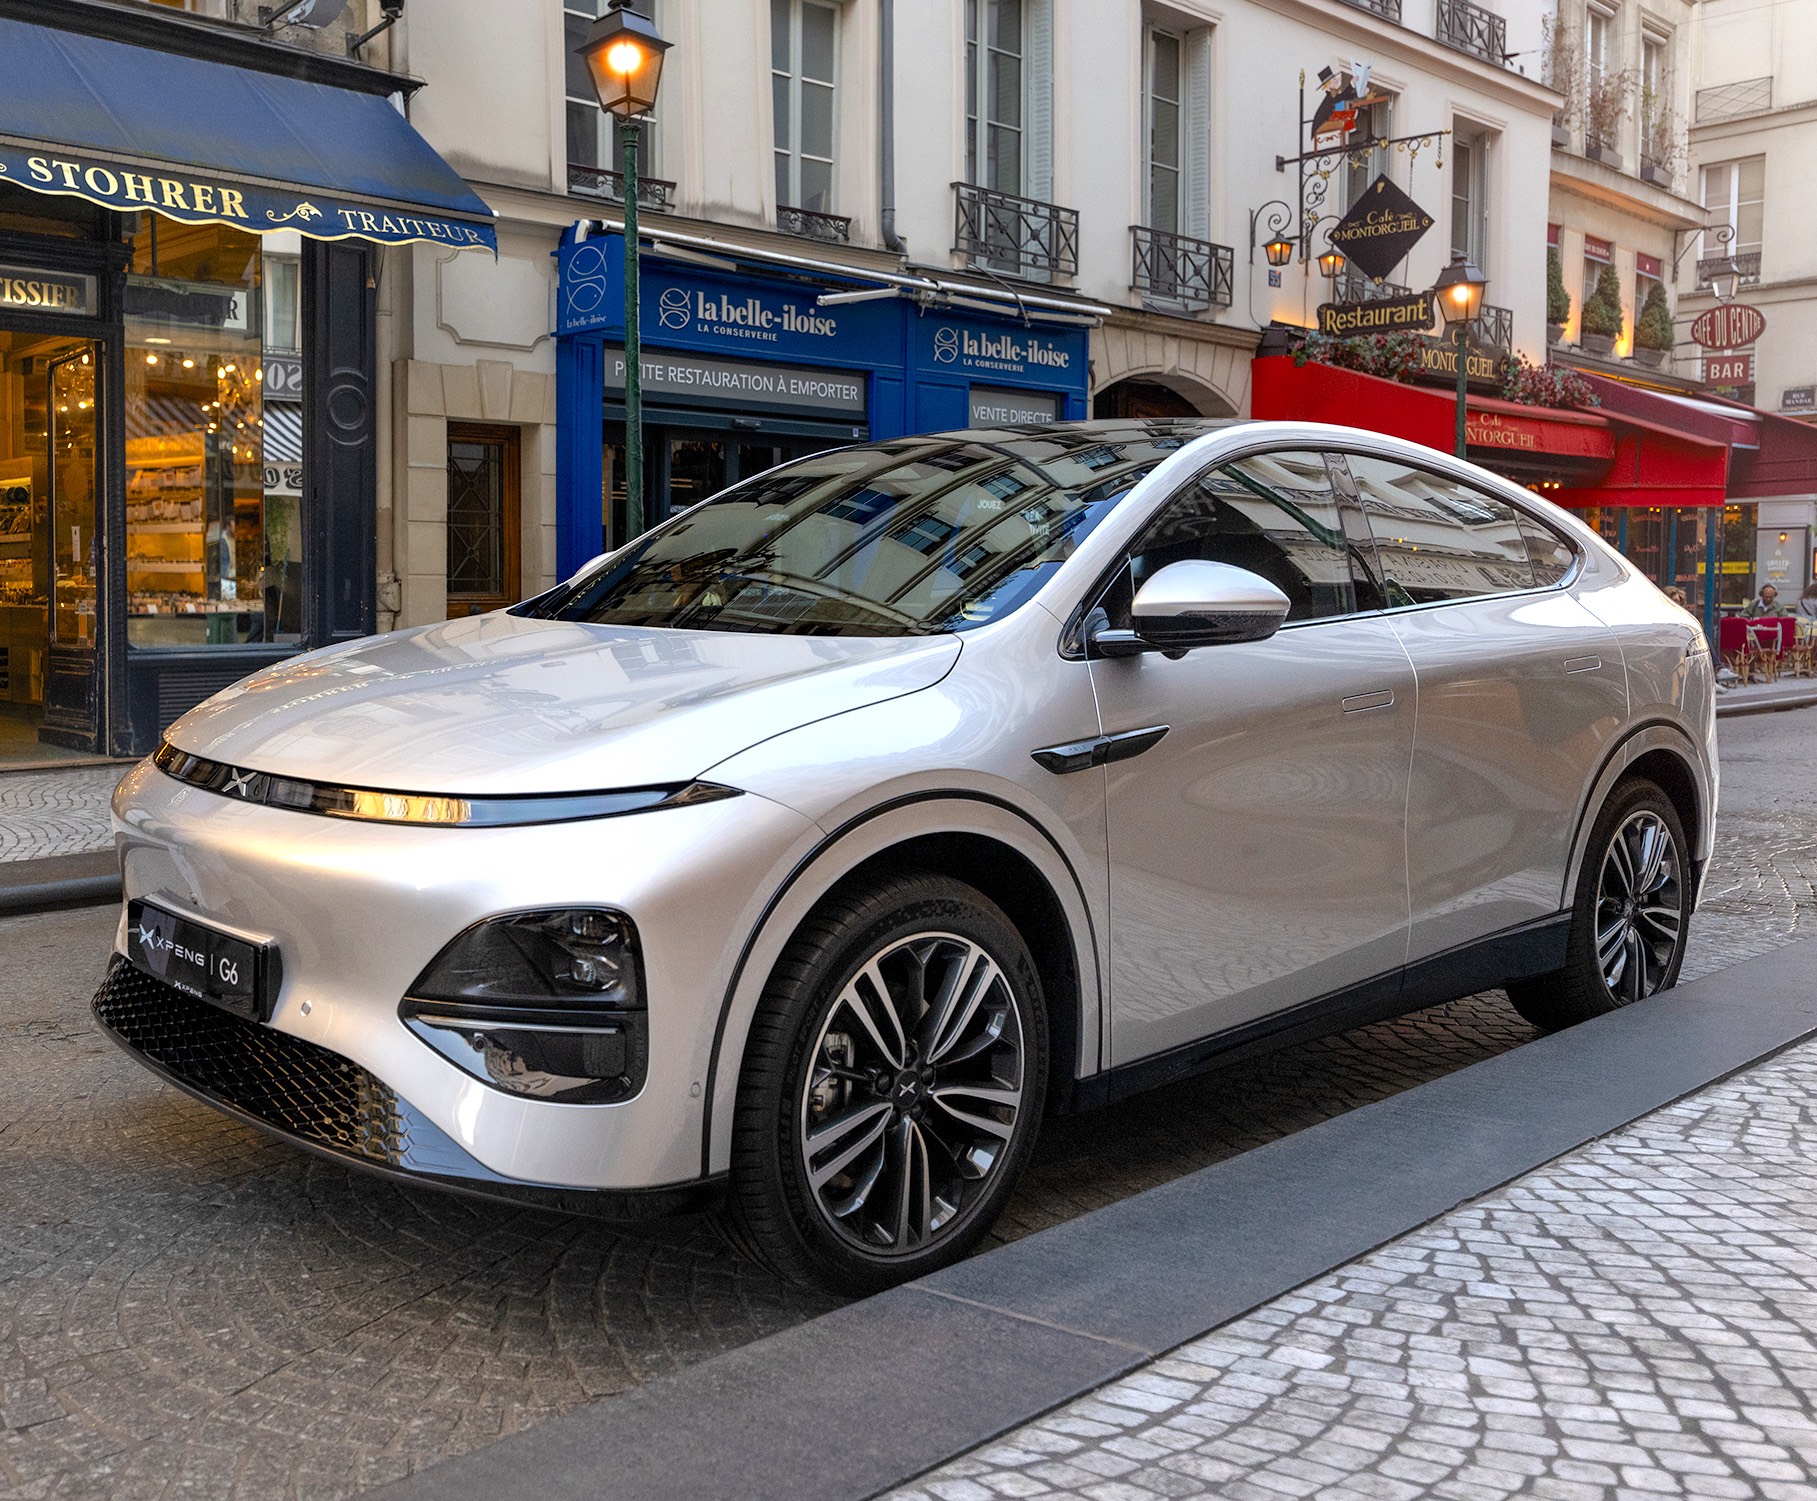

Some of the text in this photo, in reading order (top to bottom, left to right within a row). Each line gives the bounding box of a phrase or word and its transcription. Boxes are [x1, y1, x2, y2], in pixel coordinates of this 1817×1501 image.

[27, 157, 249, 218] STOHRER
[338, 209, 486, 244] TRAITEUR
[1341, 219, 1420, 241] MONTORGUEIL
[0, 277, 79, 308] ISSIER
[697, 291, 837, 337] la belle-iloise
[1326, 298, 1428, 335] Restaurant
[1715, 308, 1727, 347] DU
[1730, 307, 1761, 345] CENTRE
[698, 324, 778, 342] LA CONSERVERIE
[963, 330, 1069, 368] la belle-iloise
[963, 358, 1024, 373] LA CONSERVERIE
[1421, 348, 1496, 378] MONTOGUEIL
[1710, 362, 1744, 379] BAR
[668, 366, 773, 392] RESTAURATION
[776, 375, 787, 393] À
[790, 379, 858, 401] EMPORTER
[973, 405, 1052, 424] VENTE DIRECTE
[157, 936, 238, 985] XPENG G6
[181, 983, 203, 998] XPENG
